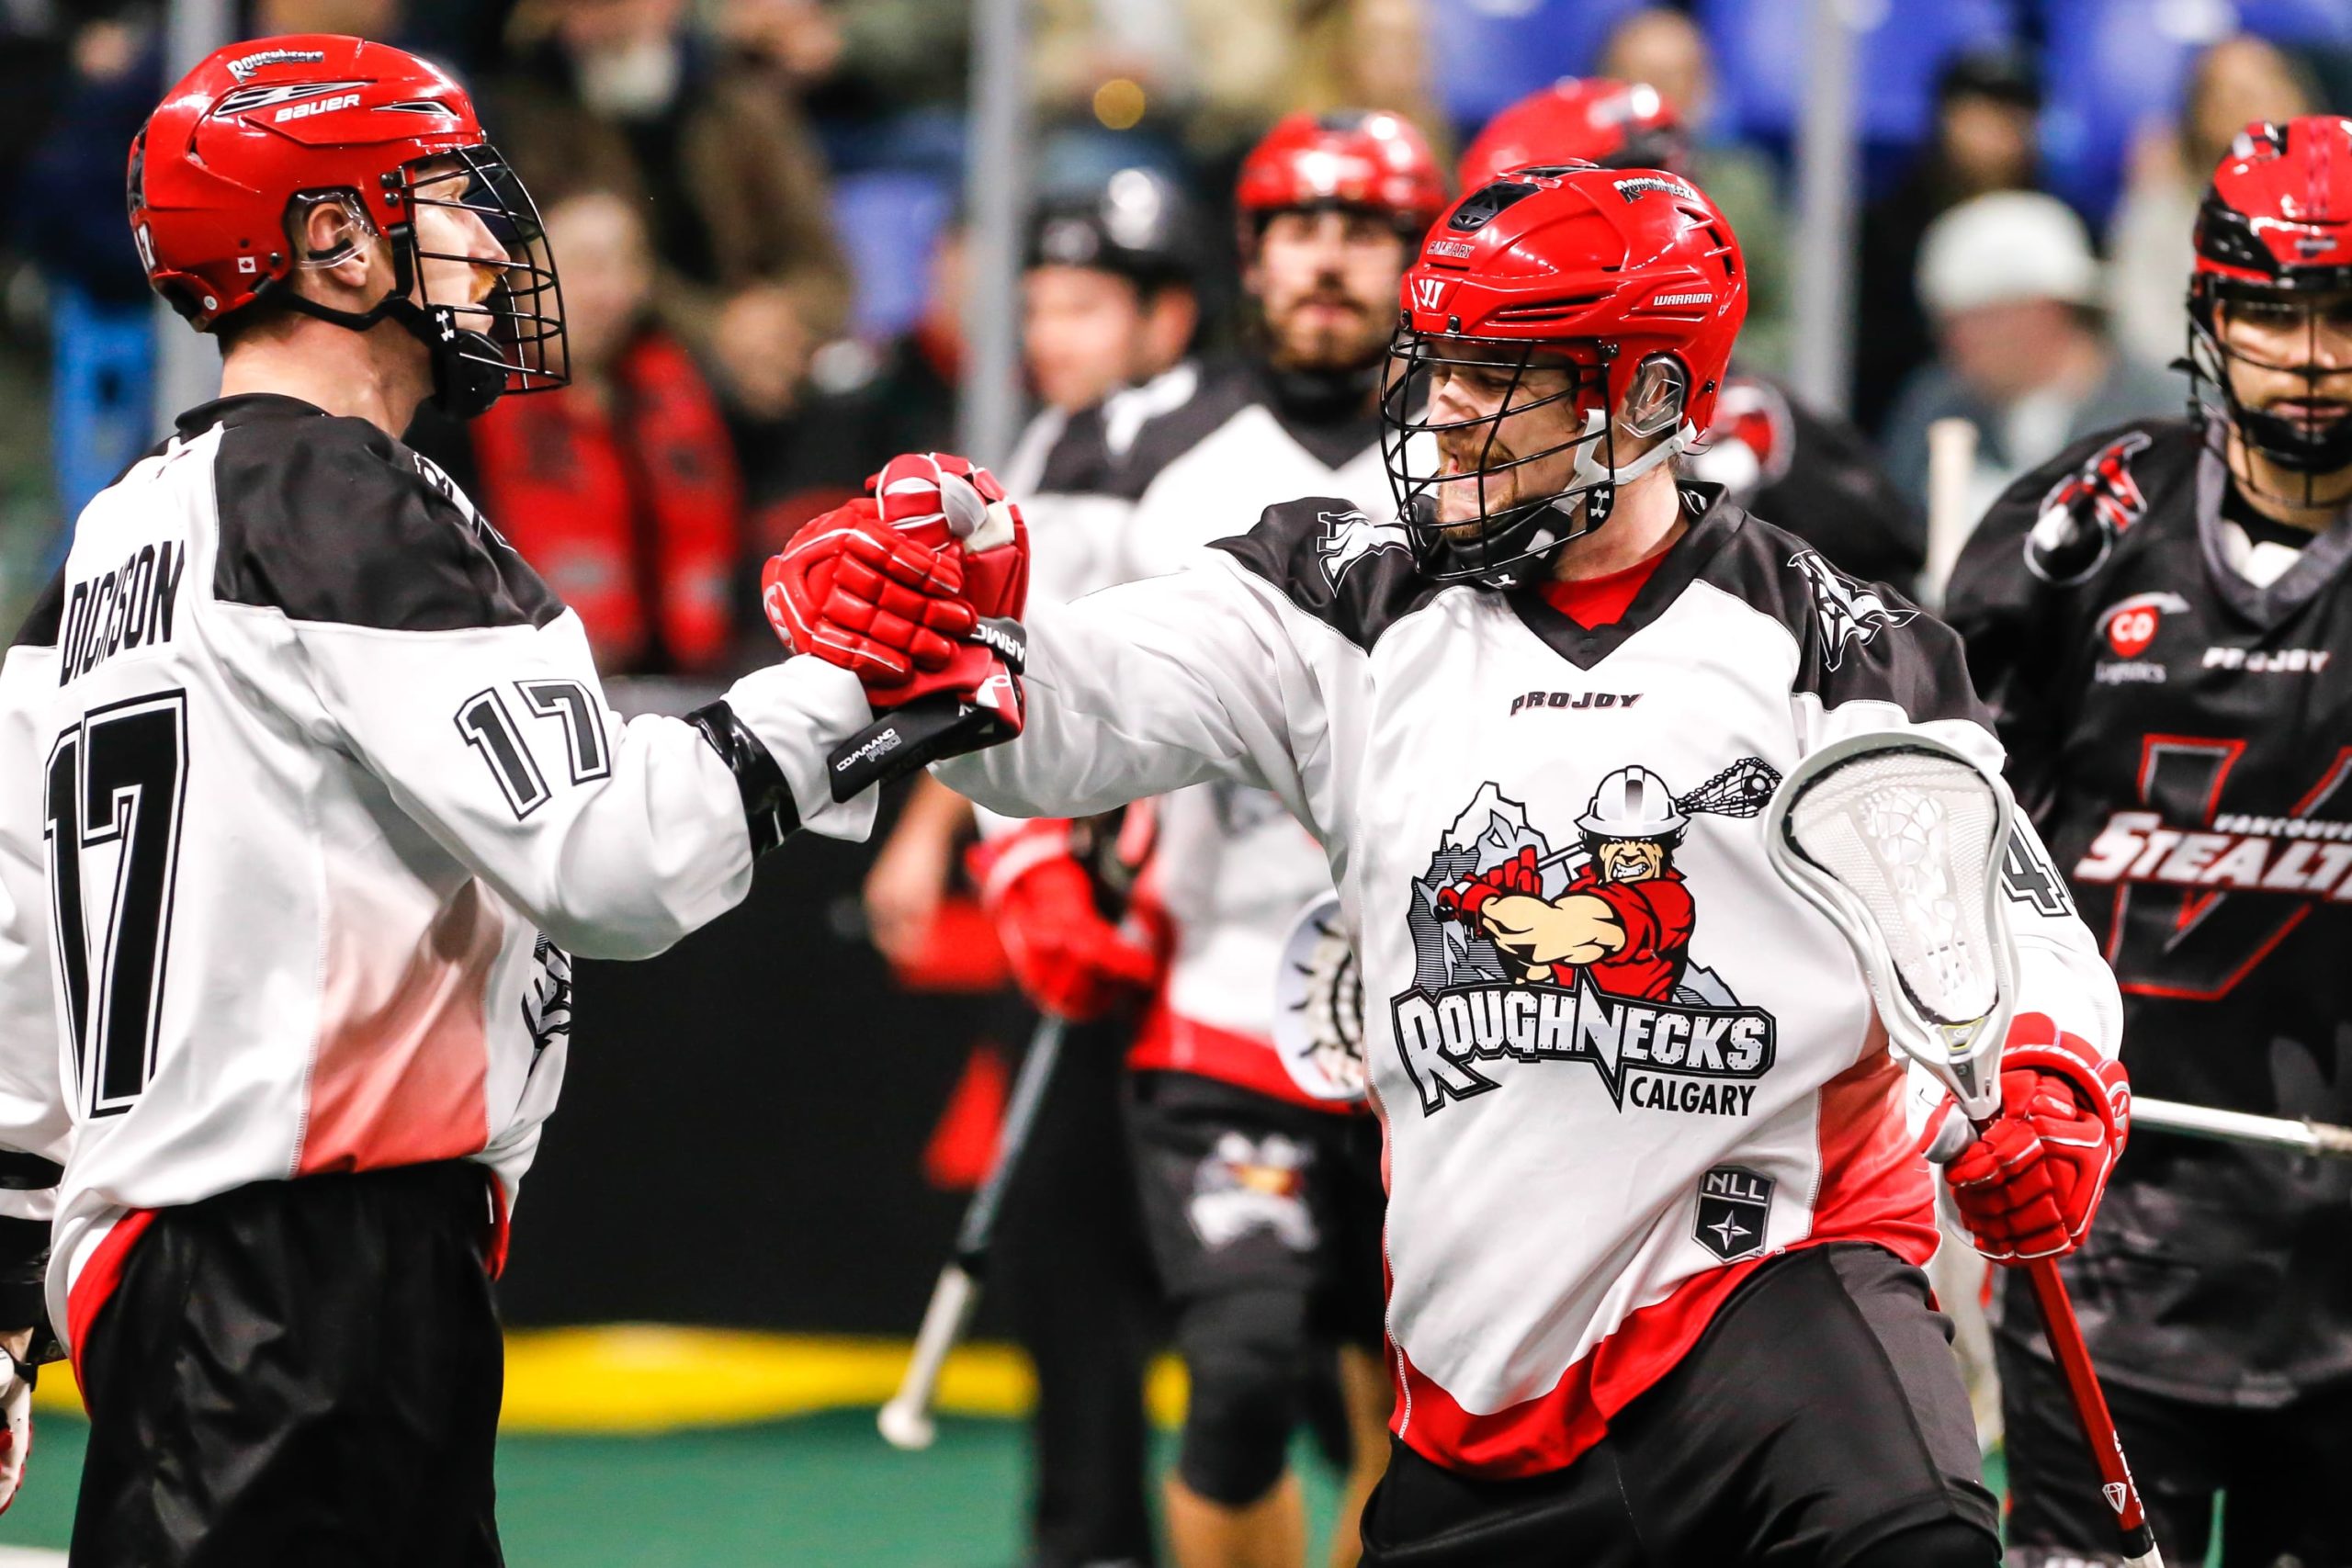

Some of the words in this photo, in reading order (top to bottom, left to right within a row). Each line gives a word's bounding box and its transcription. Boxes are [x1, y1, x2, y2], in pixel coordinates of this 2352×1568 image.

[275, 94, 360, 123] BAUER
[1654, 293, 1713, 306] WARRIOR
[1510, 689, 1645, 717] PROJOY
[454, 679, 611, 821] 17
[836, 728, 897, 772] COMMAND
[43, 687, 189, 1120] 17
[1390, 970, 1776, 1118] ROUGHNECKS
[1629, 1077, 1757, 1117] CALGARY
[1706, 1172, 1765, 1201] NLL
